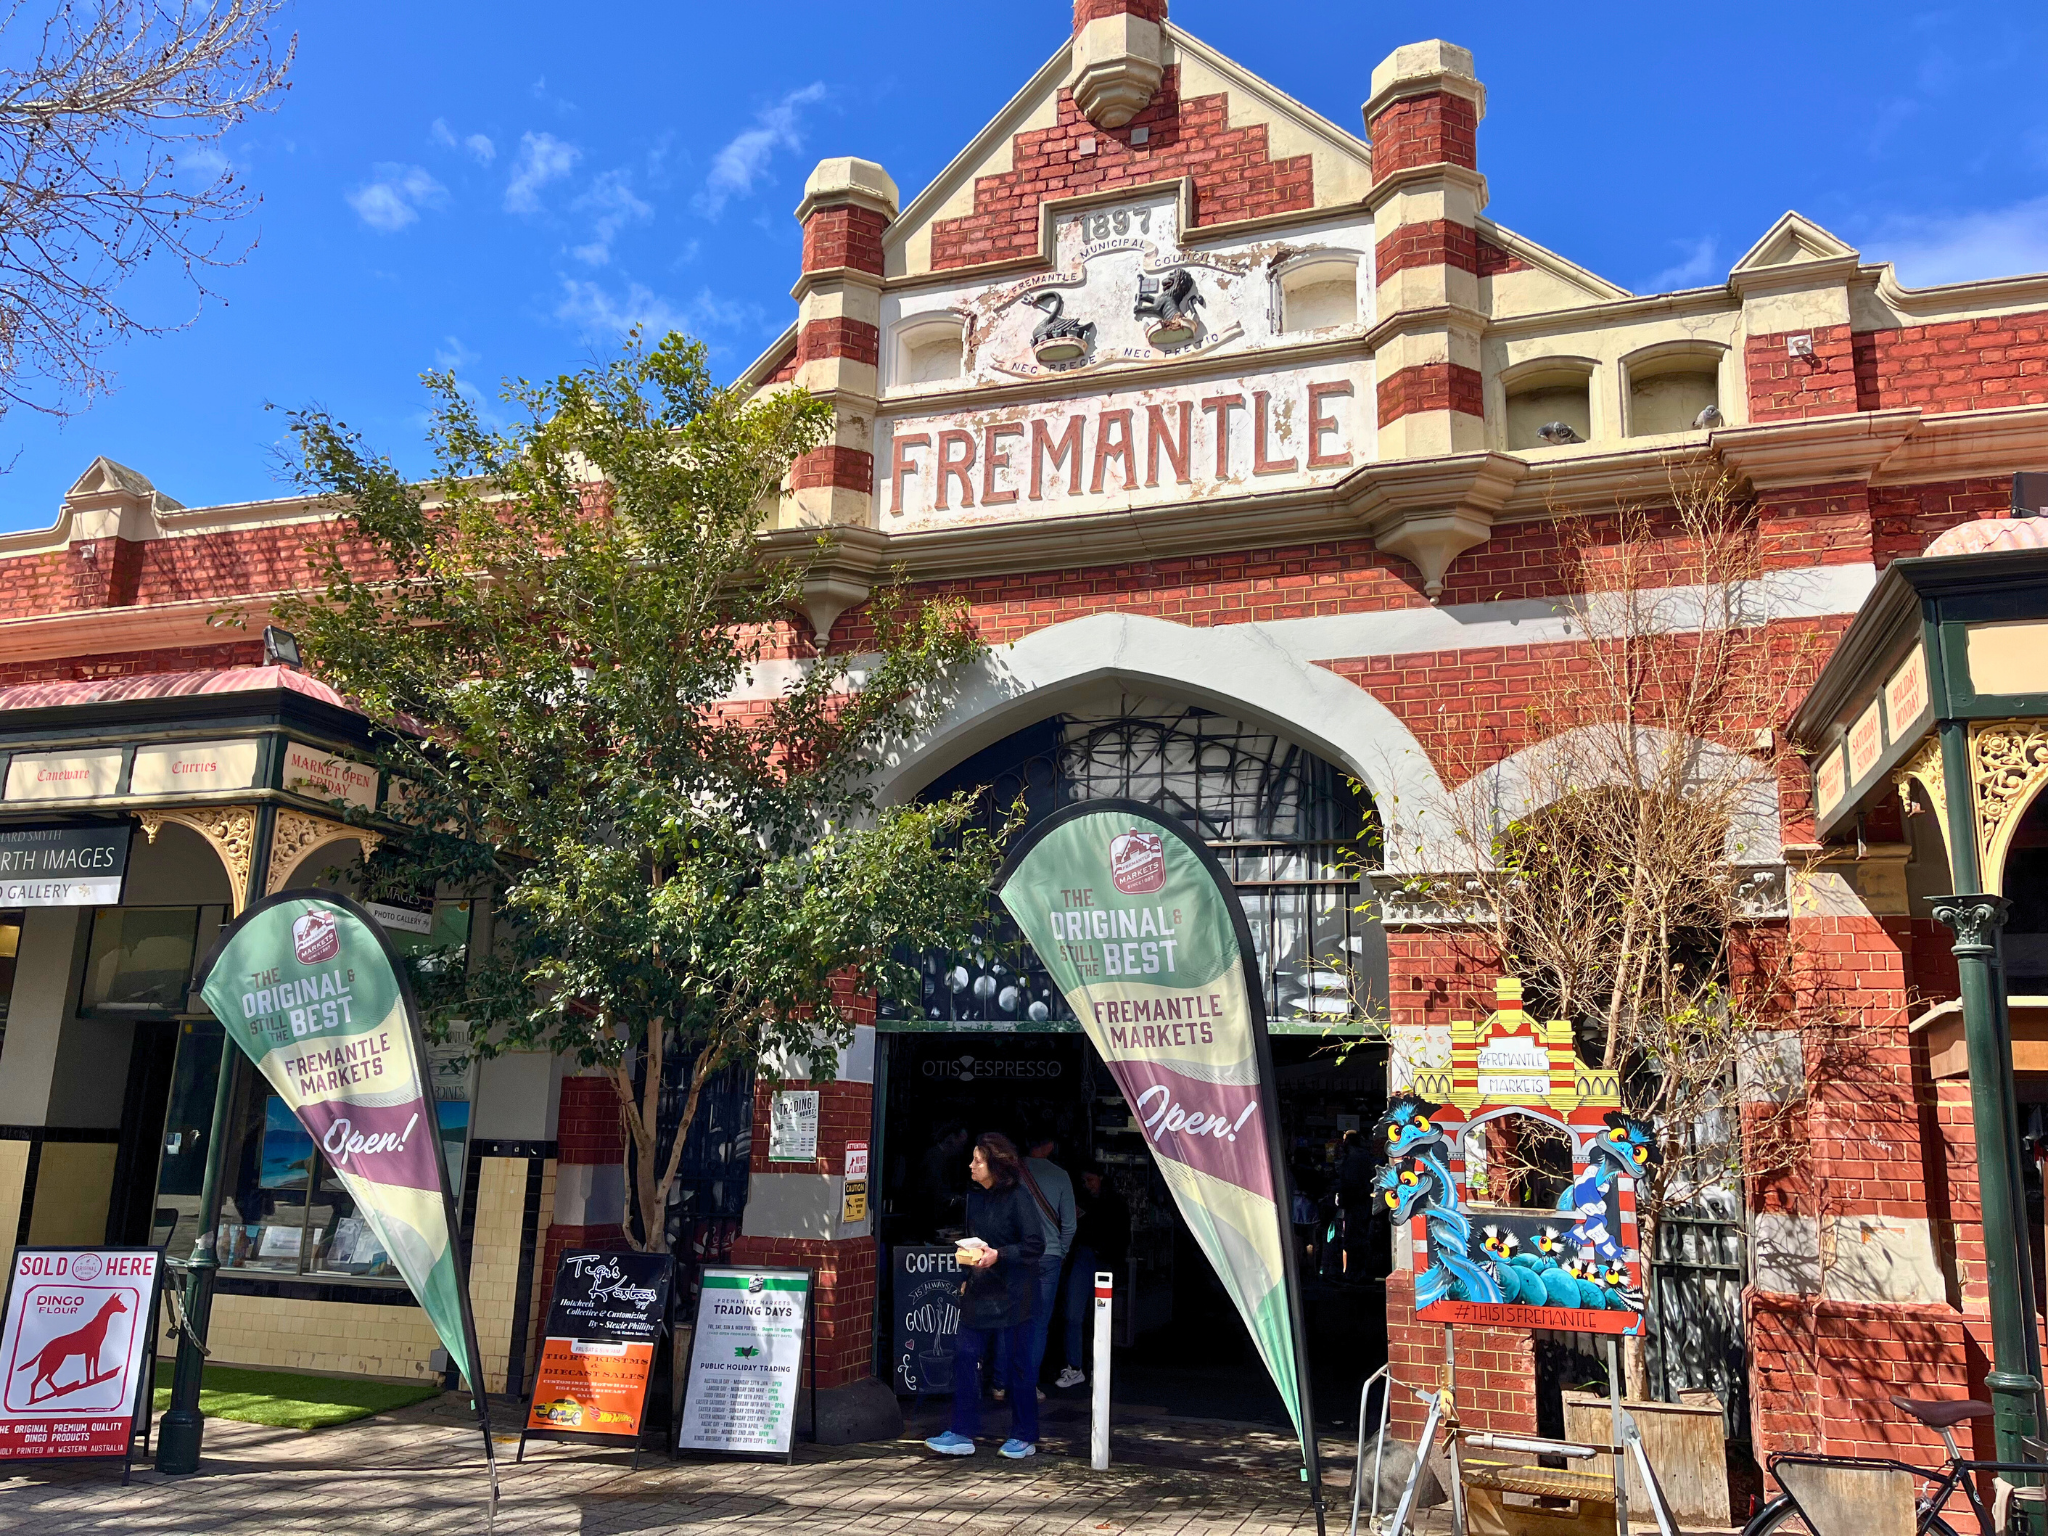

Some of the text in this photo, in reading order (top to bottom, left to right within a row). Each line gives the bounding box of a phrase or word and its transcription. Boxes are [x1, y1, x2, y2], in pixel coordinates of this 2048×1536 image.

[1081, 206, 1150, 244] 1897
[1012, 238, 1211, 294] FREMANTLE MUNICIPAL COUNCIL
[1012, 333, 1218, 374] NEC PRECE NEC PRETIO
[890, 379, 1354, 517] FREMANTLE
[1892, 658, 1918, 708] HOLIDAY
[1896, 684, 1920, 731] MONDAY
[1852, 707, 1877, 755] SATURDAY
[1858, 736, 1876, 773] SUNDAY
[36, 768, 90, 782] Caneware
[172, 761, 218, 774] Curries
[291, 754, 370, 788] MARKET OPEN
[310, 775, 350, 796] FRIDAY
[28, 830, 62, 841] SMYTH
[1, 847, 115, 870] RTH IMAGES
[1120, 862, 1158, 884] MARKETS
[8, 884, 72, 899] GALLERY
[385, 886, 420, 904] MAGES
[1061, 889, 1094, 908] THE
[374, 910, 421, 926] PHOTO GALLERY
[1050, 906, 1182, 940] ORIGINAL &
[302, 933, 334, 958] MARKETS
[1060, 944, 1098, 962] STILL
[1102, 940, 1178, 976] BEST
[252, 968, 280, 988] THE
[1077, 964, 1099, 977] THE
[242, 970, 350, 1018] ORIGINAL
[290, 996, 352, 1037] BEST
[1094, 994, 1222, 1024] FREMANTLE
[250, 1015, 287, 1035] STILL
[1110, 1022, 1212, 1048] MARKETS
[269, 1030, 289, 1042] THE
[285, 1033, 390, 1076] FREMANTLE
[1478, 1052, 1542, 1066] #FREMANTLE
[300, 1058, 383, 1096] MARKETS
[922, 1061, 1061, 1076] OTIS ESPRESSO
[1490, 1079, 1544, 1092] MARKETS
[780, 1098, 812, 1115] TRADING
[1136, 1084, 1257, 1142] Open!
[324, 1113, 418, 1164] Open!
[846, 1184, 864, 1192] CAUTION
[20, 1257, 154, 1276] SOLD HERE
[915, 1289, 922, 1297] IS
[925, 1282, 950, 1290] ALWAYS
[36, 1296, 84, 1306] DINGO
[714, 1305, 792, 1316] TRADING DAYS
[607, 1310, 648, 1320] Customizing
[906, 1304, 936, 1334] GOOD
[1454, 1304, 1596, 1328] #THISISFREMANTLE
[544, 1368, 600, 1376] DIECAST
[700, 1362, 724, 1370] PUBLIC
[726, 1364, 757, 1372] HOLIDAY
[14, 1425, 48, 1434] ORIGINAL
[53, 1424, 87, 1432] PREMIUM
[92, 1422, 122, 1431] QUALITY
[24, 1432, 90, 1442] DINGO PRODUCTS
[90, 1444, 124, 1452] AUSTRALIA
